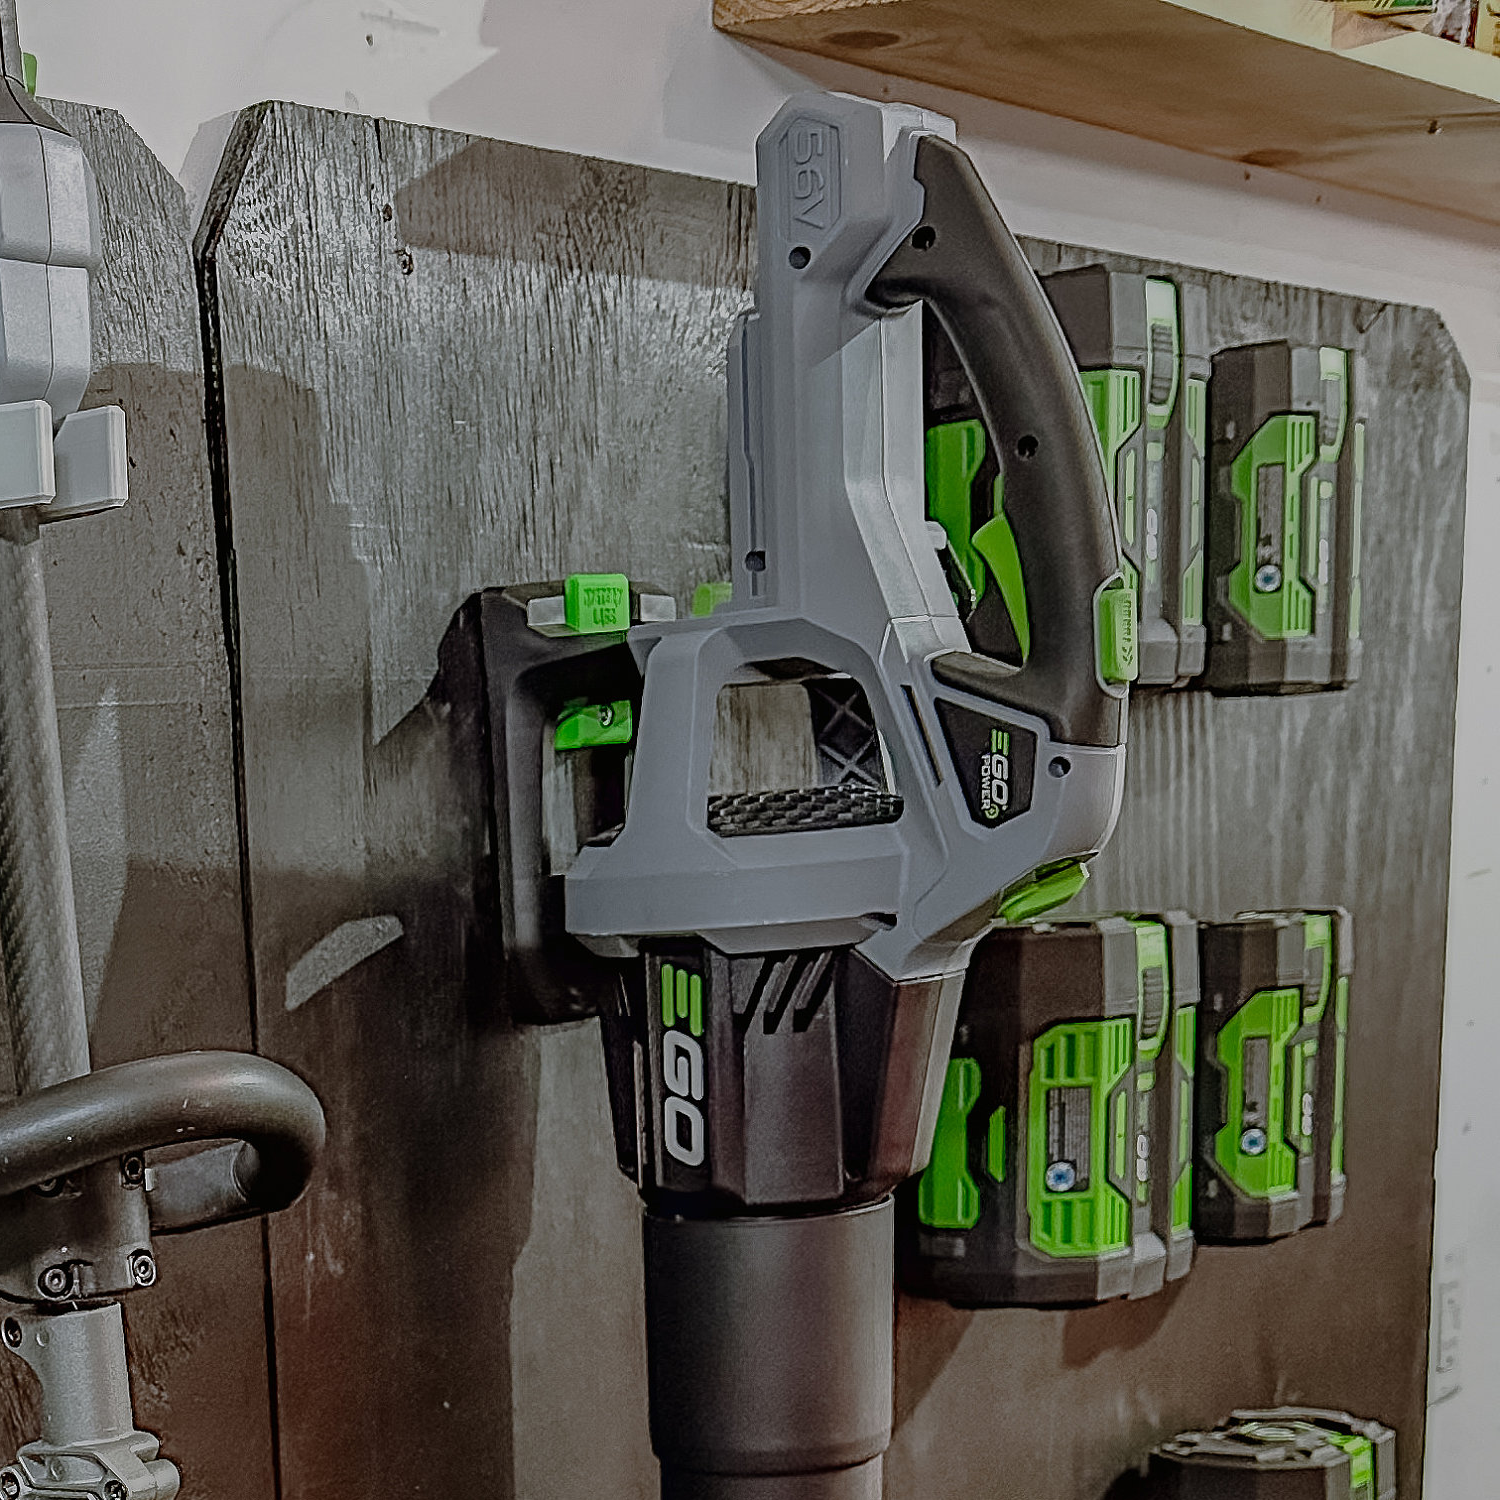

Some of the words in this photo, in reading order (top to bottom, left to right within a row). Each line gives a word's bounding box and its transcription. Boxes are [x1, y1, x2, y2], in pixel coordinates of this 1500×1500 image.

[792, 130, 825, 230] 56V
[981, 755, 991, 810] POWER
[991, 729, 1009, 805] EGO
[662, 963, 704, 1166] EGO
